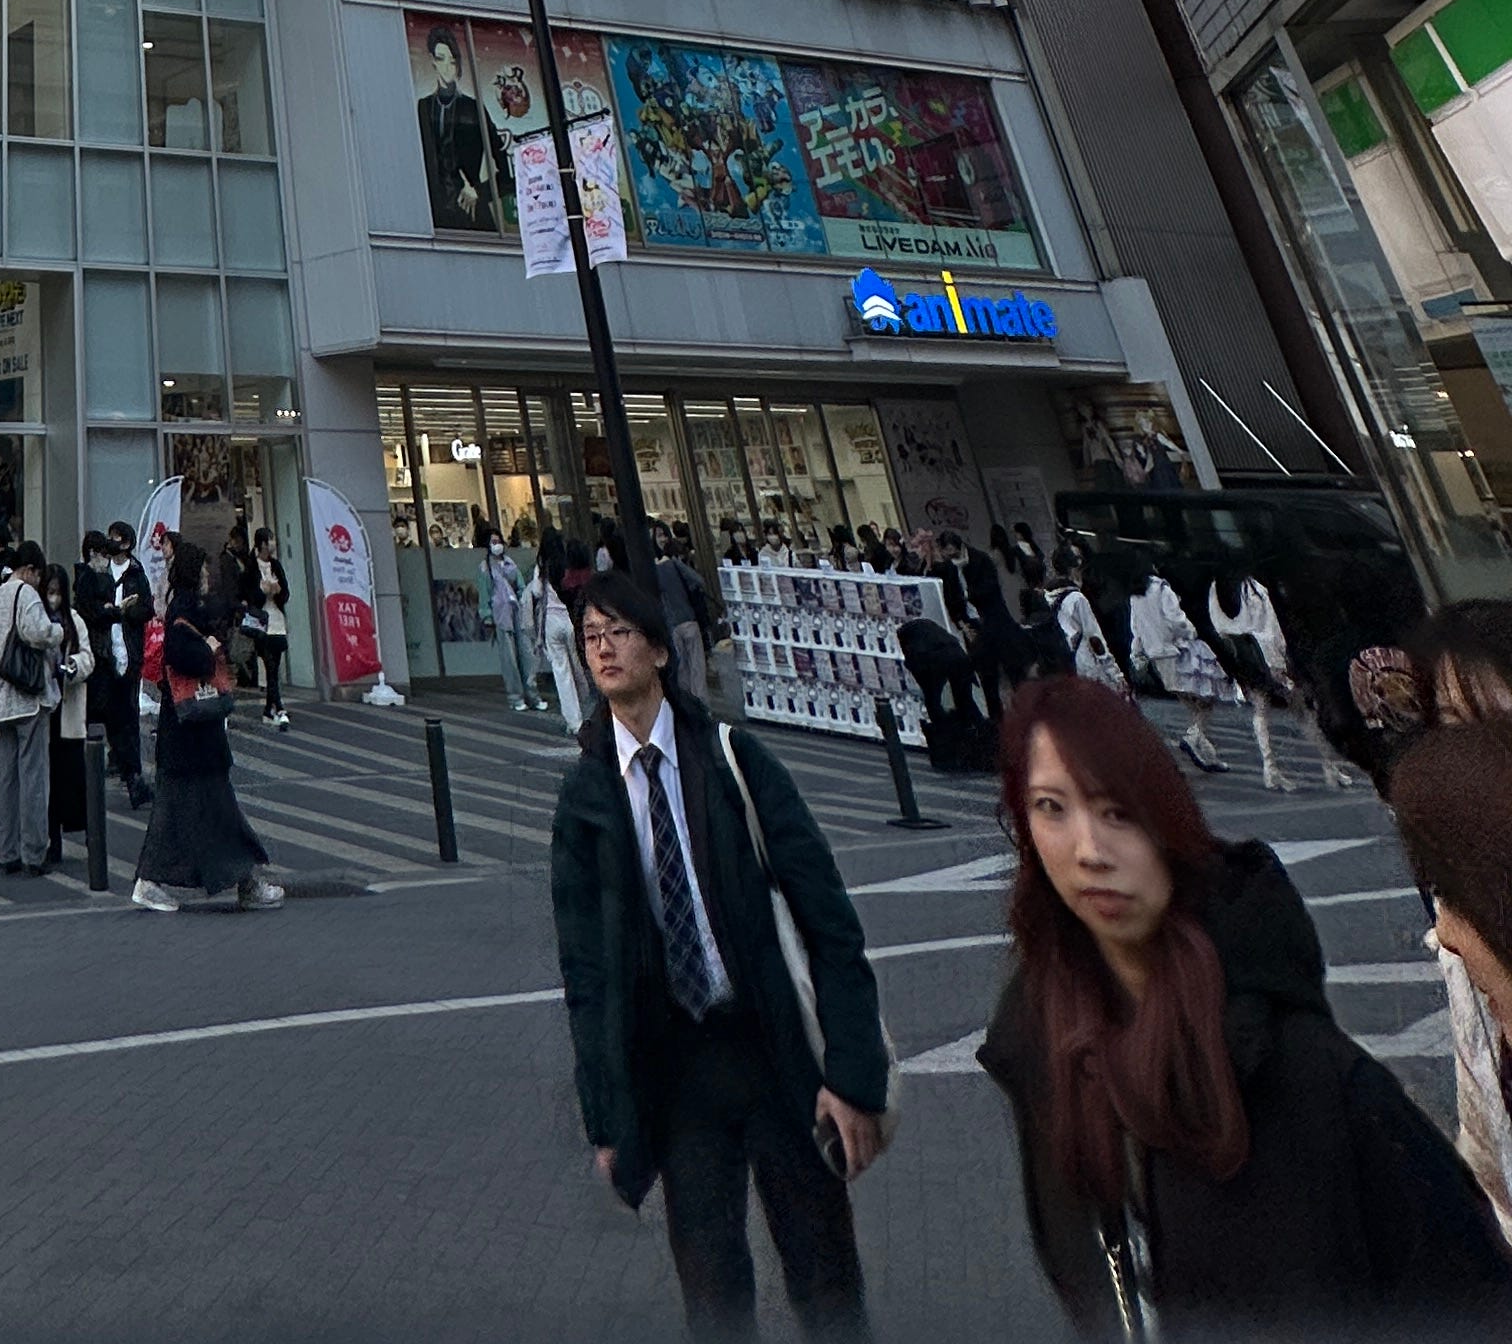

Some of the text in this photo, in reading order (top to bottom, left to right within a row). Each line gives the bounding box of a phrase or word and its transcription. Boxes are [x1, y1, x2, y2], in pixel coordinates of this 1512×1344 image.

[810, 136, 896, 189] エモい。
[904, 270, 1057, 338] animate
